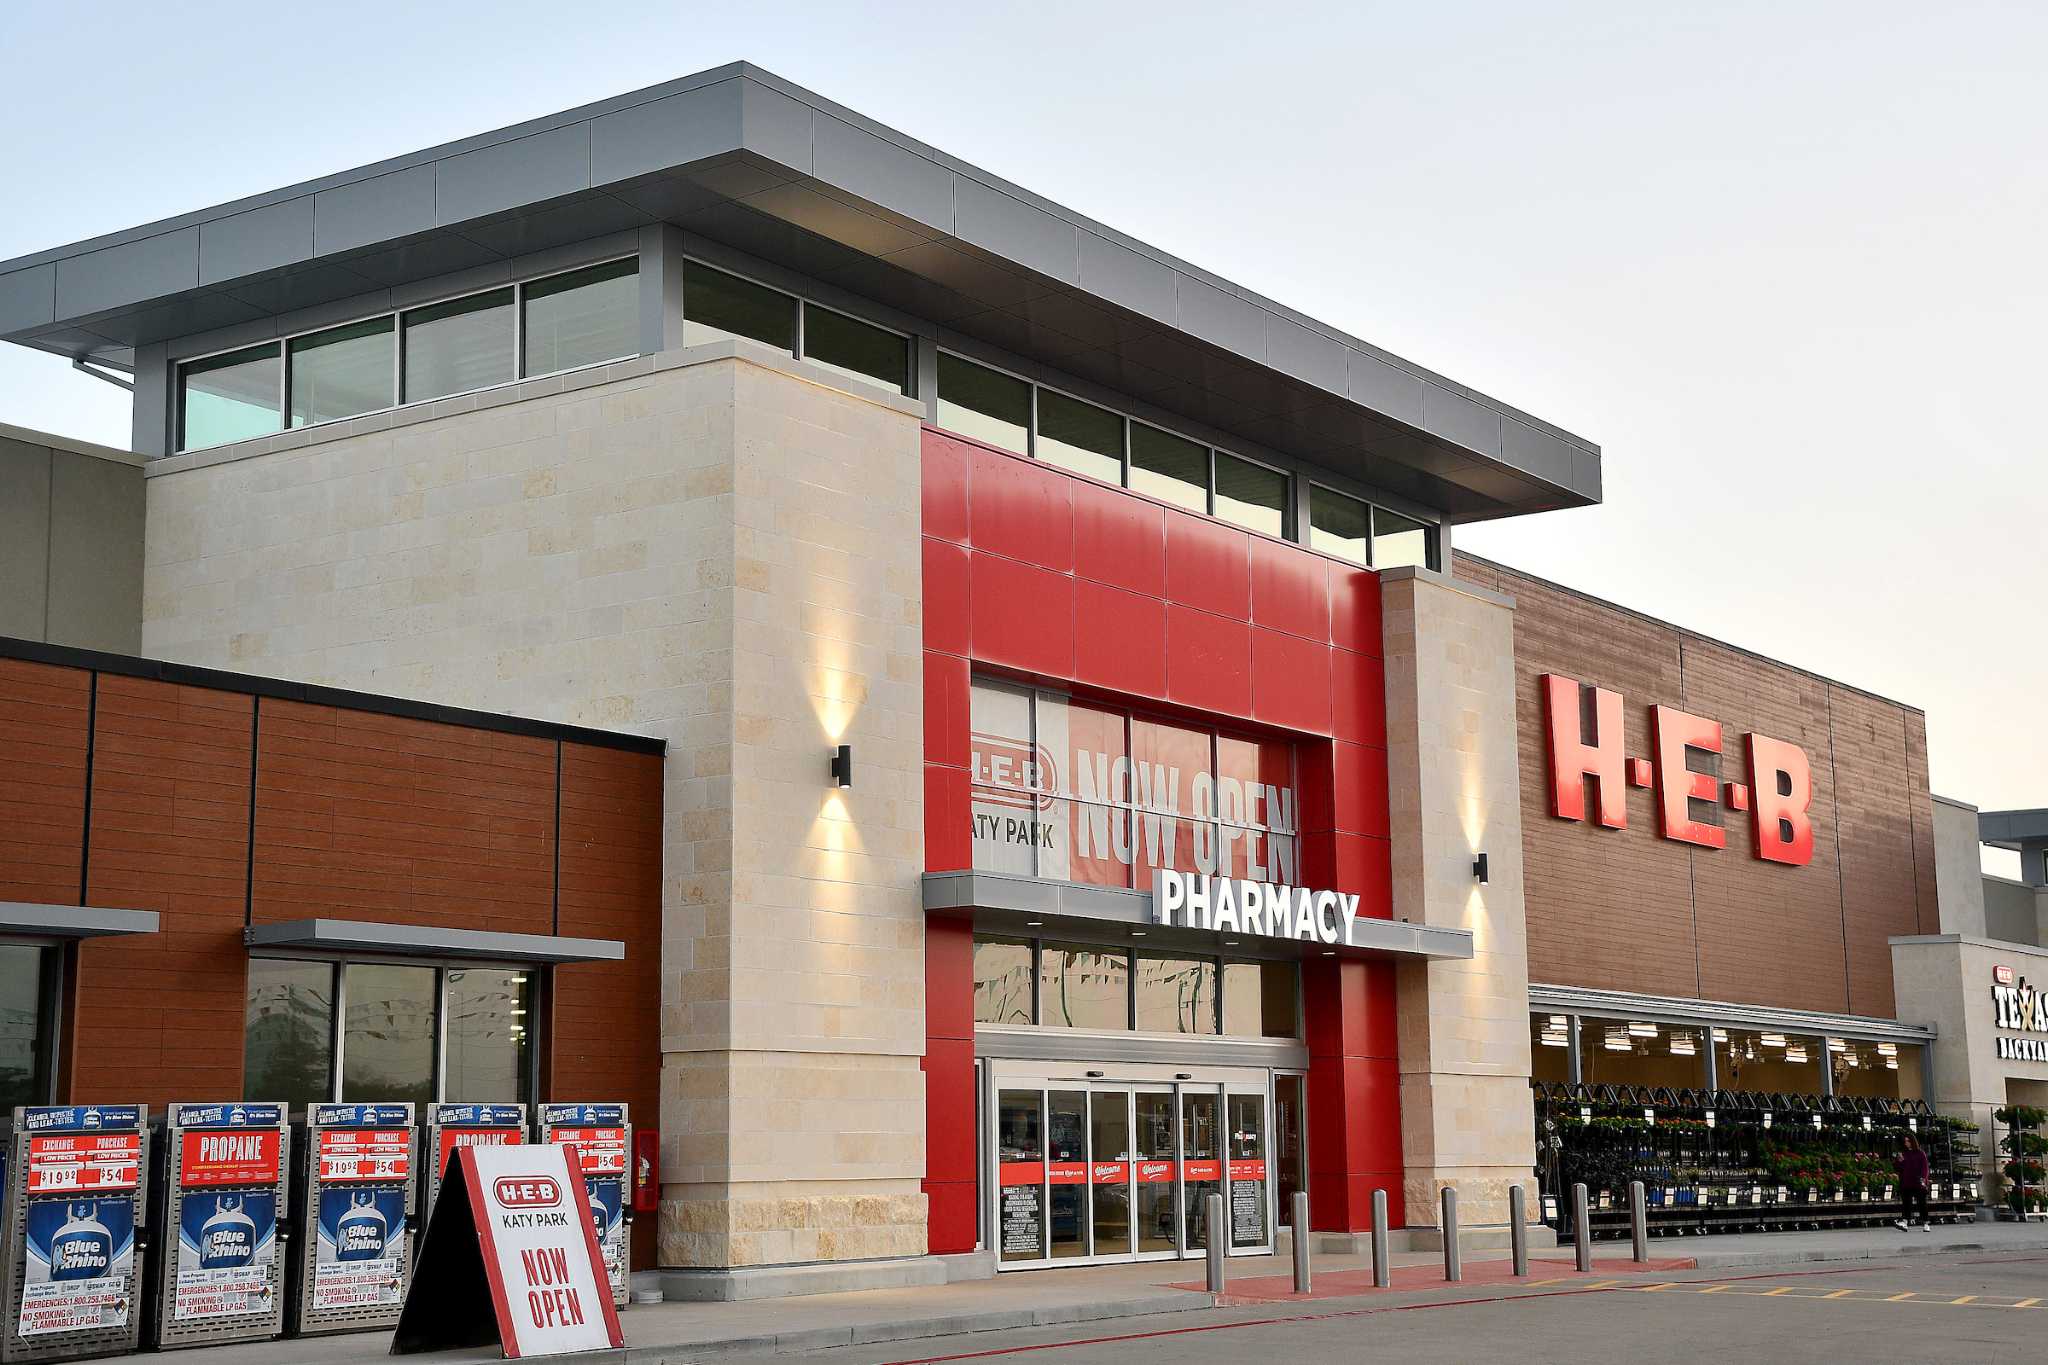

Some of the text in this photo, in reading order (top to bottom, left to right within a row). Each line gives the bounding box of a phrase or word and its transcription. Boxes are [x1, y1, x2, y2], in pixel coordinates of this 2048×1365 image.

[1541, 673, 1815, 867] H-E-B
[1077, 749, 1179, 870] NOW
[1191, 771, 1294, 886] OPEN
[1156, 868, 1360, 946] PHARMACY
[42, 1138, 75, 1151] EXCHANGE
[96, 1137, 128, 1149] PURCHASE
[200, 1135, 263, 1162] PROPANE
[376, 1160, 394, 1173] $54
[1094, 1164, 1121, 1177] Welcome
[1142, 1163, 1168, 1175] Welcome
[100, 1167, 122, 1182] $54
[500, 1182, 555, 1201] H-E-B
[502, 1212, 569, 1228] KATY PARK
[213, 1230, 246, 1243] Blue
[348, 1224, 377, 1237] Blue
[64, 1240, 101, 1255] Blue
[208, 1242, 251, 1259] Rhino
[343, 1237, 382, 1252] Rhino
[60, 1254, 107, 1270] Rhino
[520, 1247, 570, 1287] NOW
[324, 1287, 351, 1297] SMOKING
[366, 1293, 378, 1302] GAS
[177, 1296, 217, 1307] NO SMOKING
[186, 1301, 247, 1315] FLAMMABLE LP GAS
[527, 1287, 585, 1329] OPEN
[22, 1309, 66, 1322] NO SMOKING
[31, 1315, 100, 1330] FLAMMABLE LP GAS
